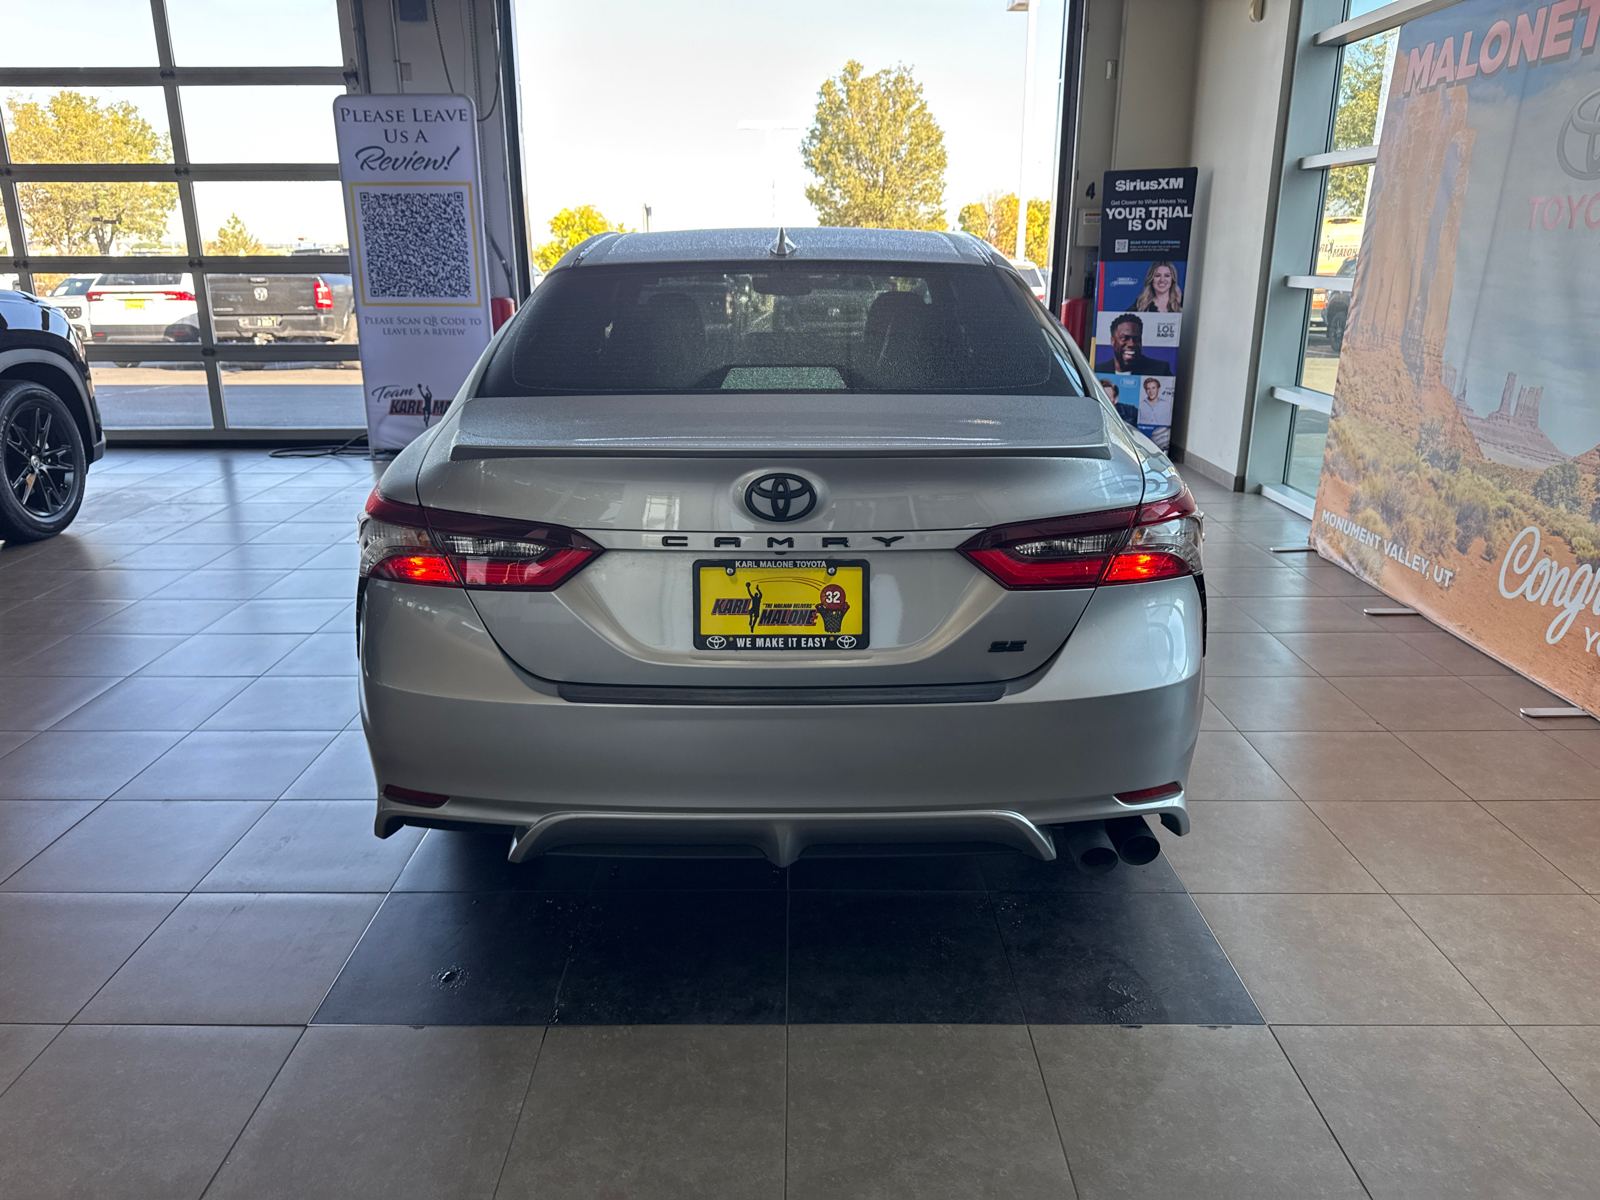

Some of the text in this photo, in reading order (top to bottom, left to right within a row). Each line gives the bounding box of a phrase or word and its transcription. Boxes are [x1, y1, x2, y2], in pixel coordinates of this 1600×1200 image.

[340, 107, 468, 123] PLEASE LEAVE
[383, 128, 429, 143] US A
[355, 145, 460, 171] Review!
[1085, 181, 1096, 200] 4
[1115, 177, 1184, 192] SiriusXM
[1105, 206, 1193, 220] YOUR TRIAL
[1128, 219, 1168, 232] IS ON
[364, 316, 482, 327] PLEASE SCAN QR CODE TO
[382, 327, 466, 336] LEAVE US A REVIEW
[1157, 325, 1175, 333] LOL
[371, 384, 415, 403] Team
[389, 400, 423, 415] KARL
[661, 535, 905, 548] CAMRY
[1321, 509, 1454, 588] MONUMENT VALLEY, UT
[735, 560, 827, 568] KARL MALONE TOYOTA
[825, 591, 840, 604] 32
[711, 598, 751, 615] KARL
[758, 609, 816, 626] MALONE
[736, 637, 827, 648] WE MAKE IT EASY
[988, 640, 1028, 653] SE
